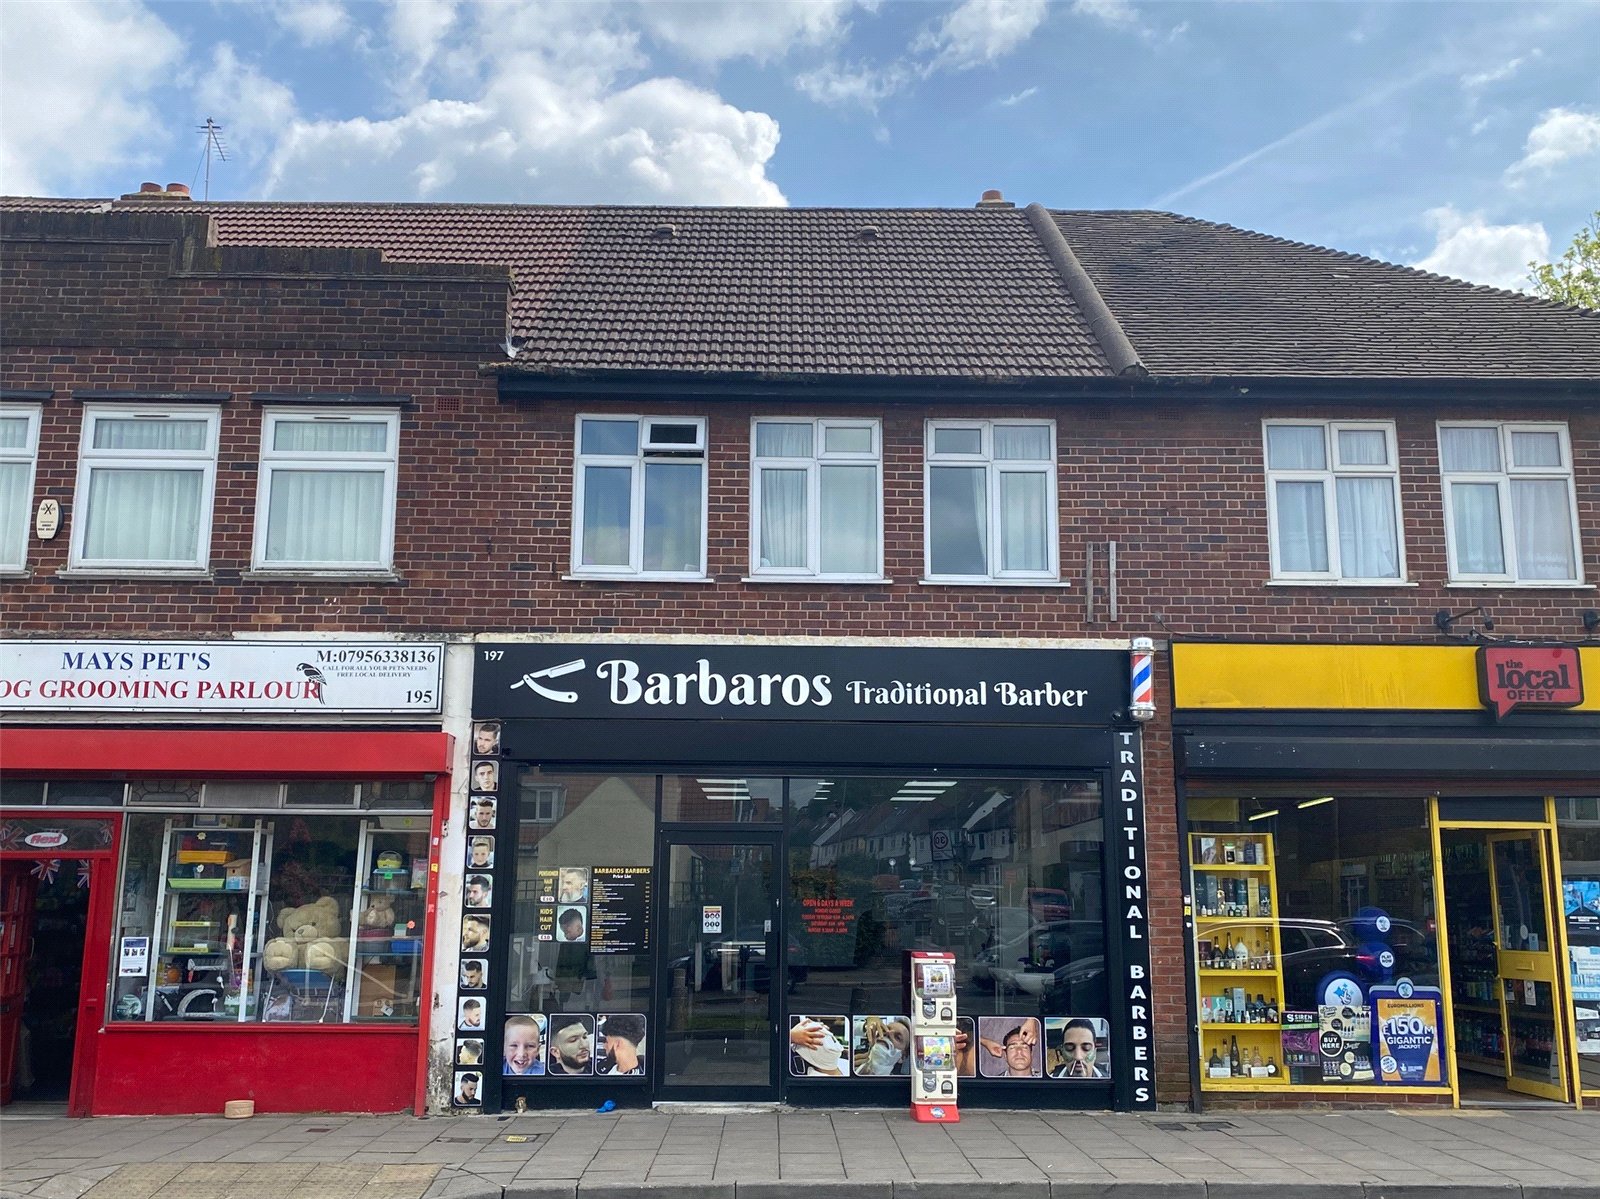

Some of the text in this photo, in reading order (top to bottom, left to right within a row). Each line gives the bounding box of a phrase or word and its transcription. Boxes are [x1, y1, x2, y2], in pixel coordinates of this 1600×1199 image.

[61, 652, 211, 671] MAYS PET'S
[316, 650, 436, 663] M:07956338136
[484, 651, 504, 661] 197
[1505, 659, 1523, 669] the
[1496, 664, 1571, 689] local
[39, 680, 188, 699] GROOMING
[197, 680, 320, 699] PARLOUR
[596, 659, 1088, 708] Barbaros Traditional Barber
[406, 690, 432, 703] 195
[1507, 690, 1555, 701] OFFEY
[803, 899, 816, 907] OPEN
[1119, 732, 1149, 1102] TRADITIONAL BARBERS
[1382, 1018, 1434, 1036] £150M
[1387, 1036, 1431, 1045] GIGANTIC
